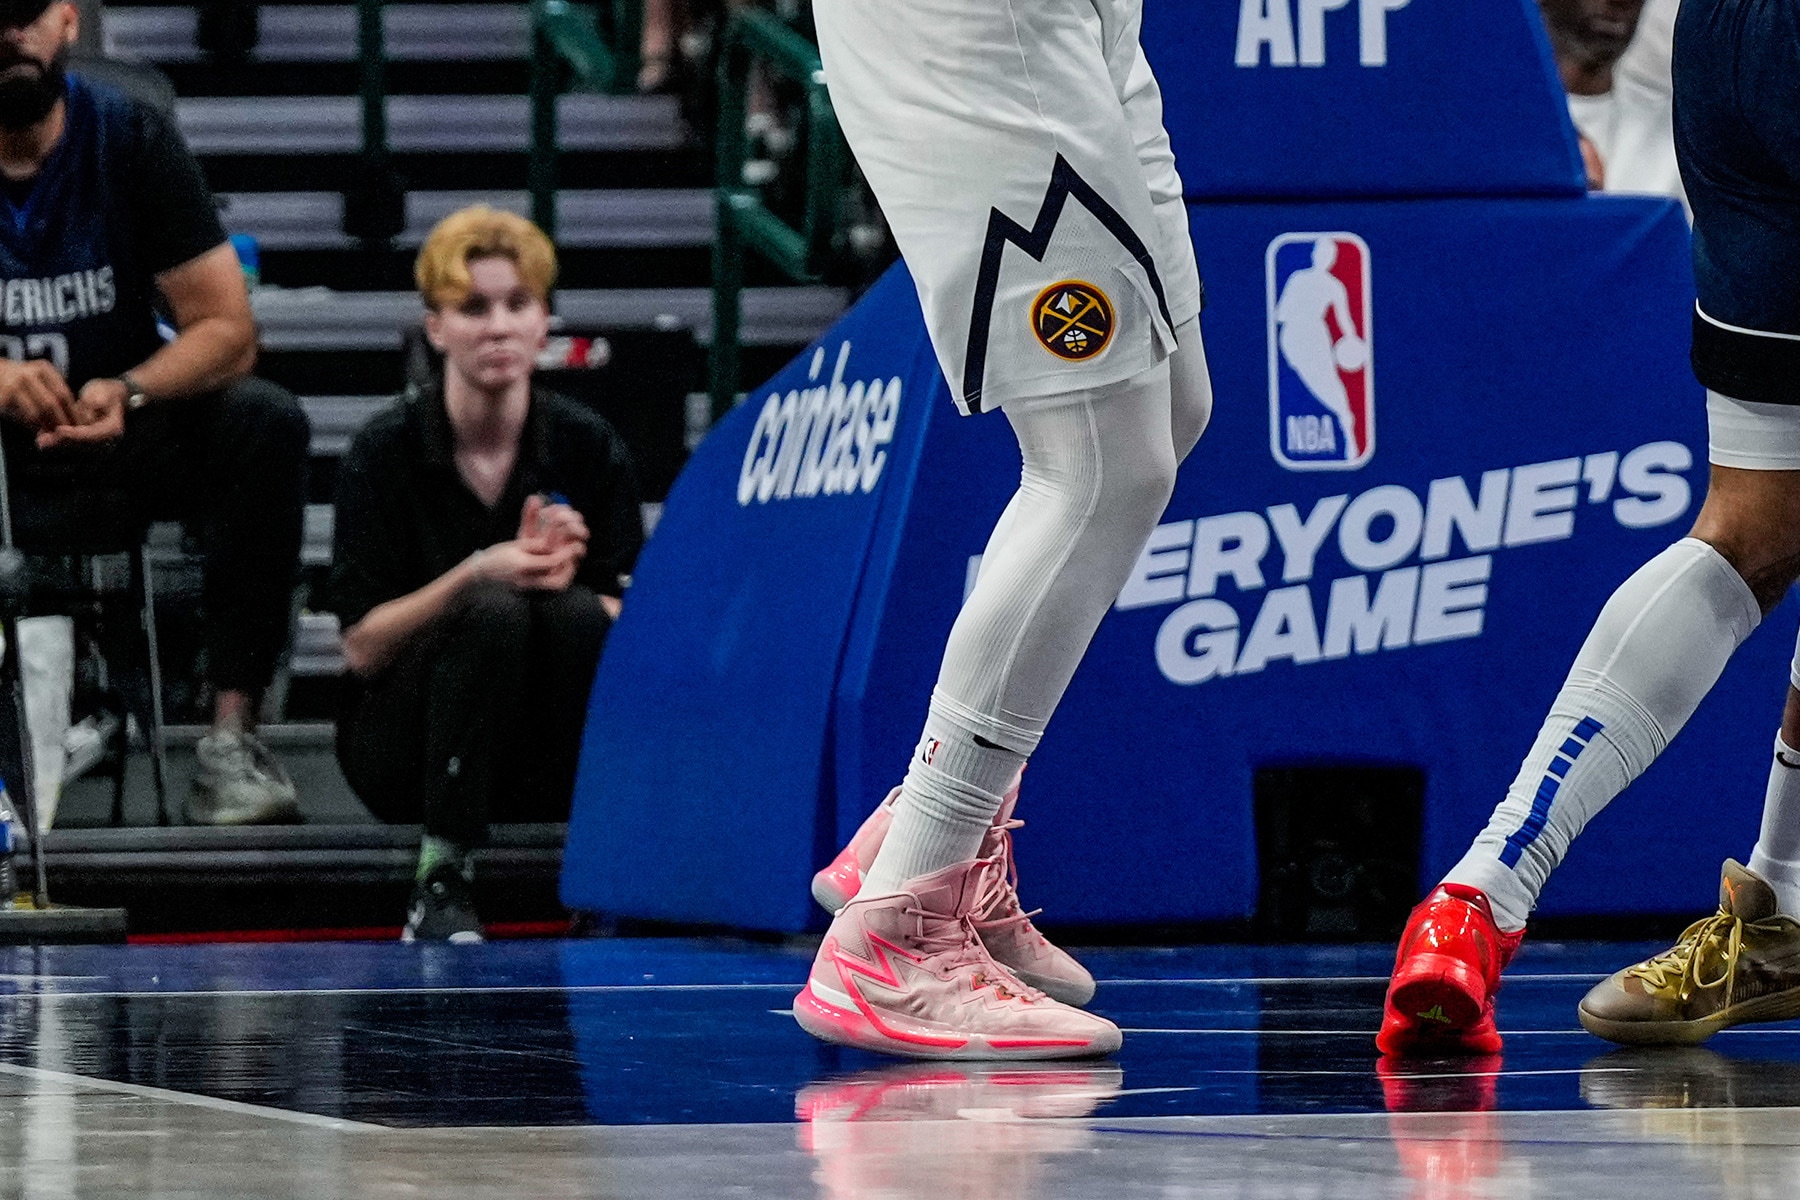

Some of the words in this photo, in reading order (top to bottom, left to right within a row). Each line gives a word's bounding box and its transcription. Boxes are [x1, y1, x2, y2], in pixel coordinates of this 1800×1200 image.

[0, 265, 116, 327] ERICKS
[737, 340, 902, 506] coinbase
[1286, 414, 1336, 453] NBA
[966, 441, 1693, 610] ERYONE'S
[1154, 554, 1494, 686] GAME
